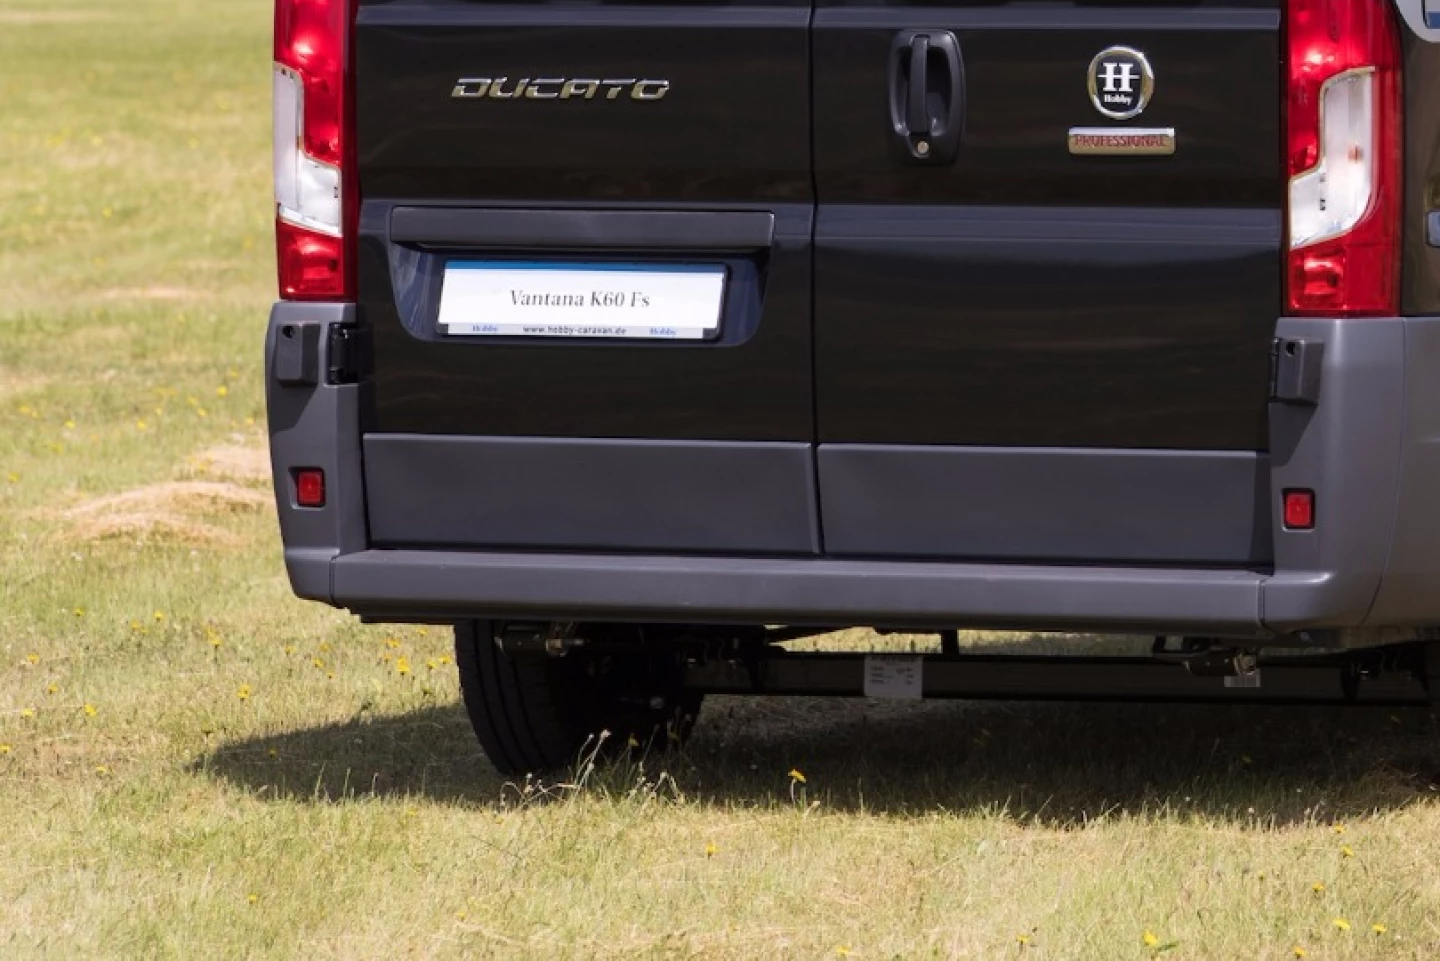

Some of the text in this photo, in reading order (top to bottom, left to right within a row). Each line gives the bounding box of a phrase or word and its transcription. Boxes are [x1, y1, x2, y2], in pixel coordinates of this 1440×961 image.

[1097, 62, 1140, 92] H
[451, 76, 670, 100] DUCATO
[1075, 135, 1166, 147] PROFESSIONAL
[510, 289, 584, 307] Vantana
[590, 290, 626, 308] K60
[523, 326, 626, 336] www.hobby-caravan.de
